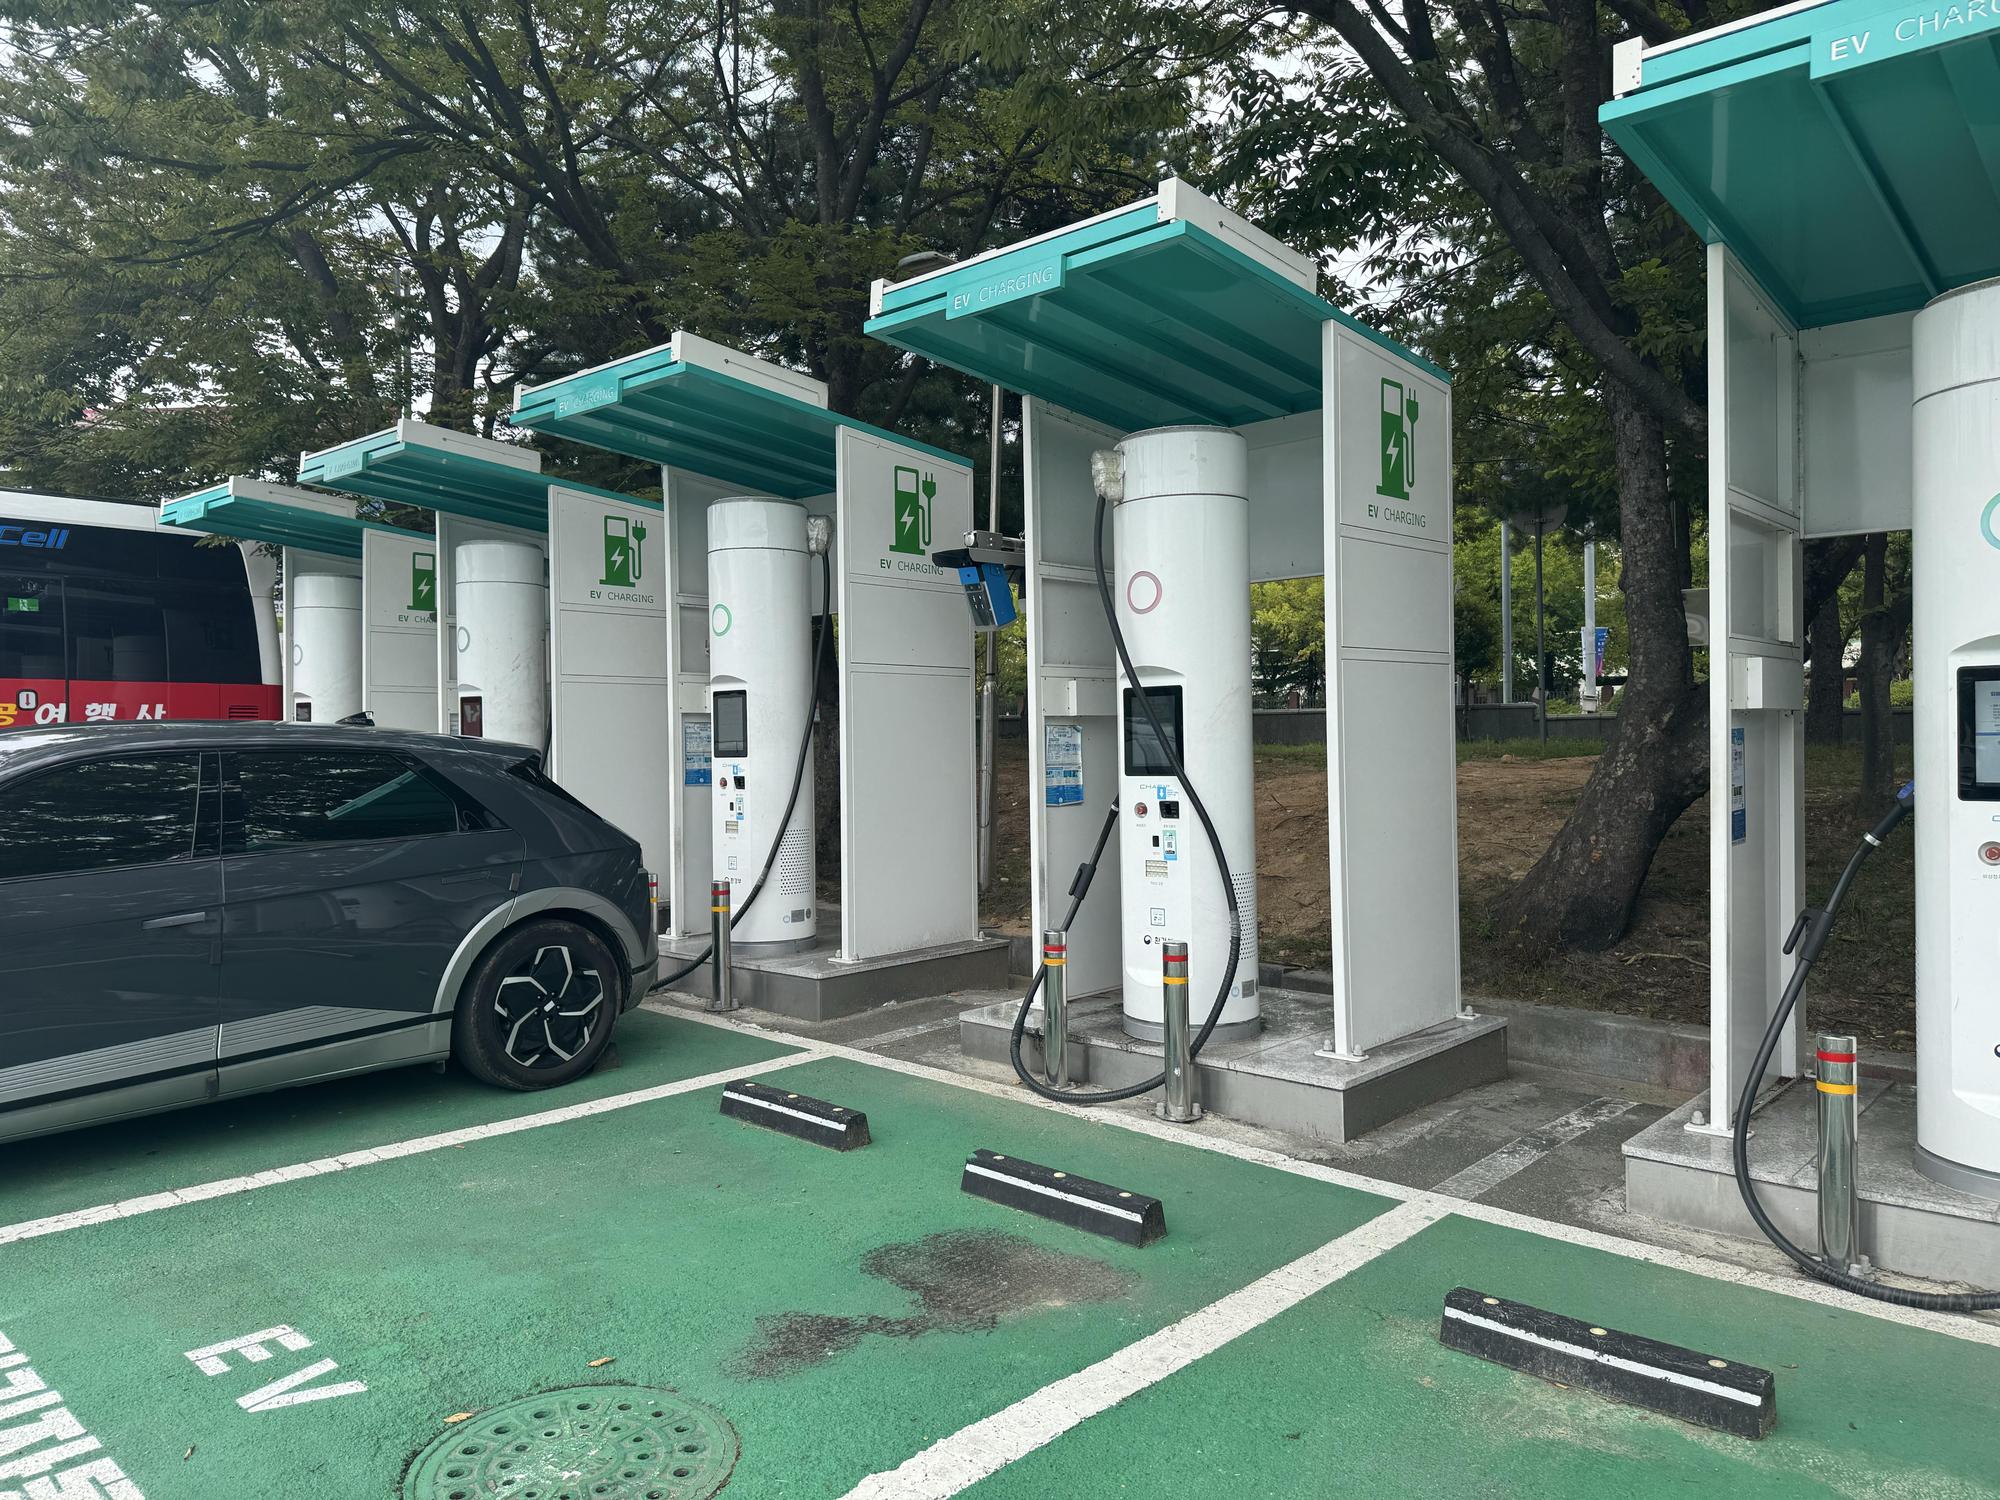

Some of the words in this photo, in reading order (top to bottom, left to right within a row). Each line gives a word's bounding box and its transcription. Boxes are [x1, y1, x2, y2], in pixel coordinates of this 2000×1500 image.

[1830, 31, 1870, 62] EV
[954, 292, 971, 310] EV
[978, 266, 1054, 303] CHARGING
[1368, 504, 1379, 519] EV
[1383, 507, 1426, 528] CHARGING
[880, 558, 892, 570] EV
[897, 560, 944, 576] CHARGING
[590, 590, 602, 599] EV
[607, 591, 654, 604] CHARGING
[398, 614, 409, 623] EV
[183, 1323, 369, 1414] EV
